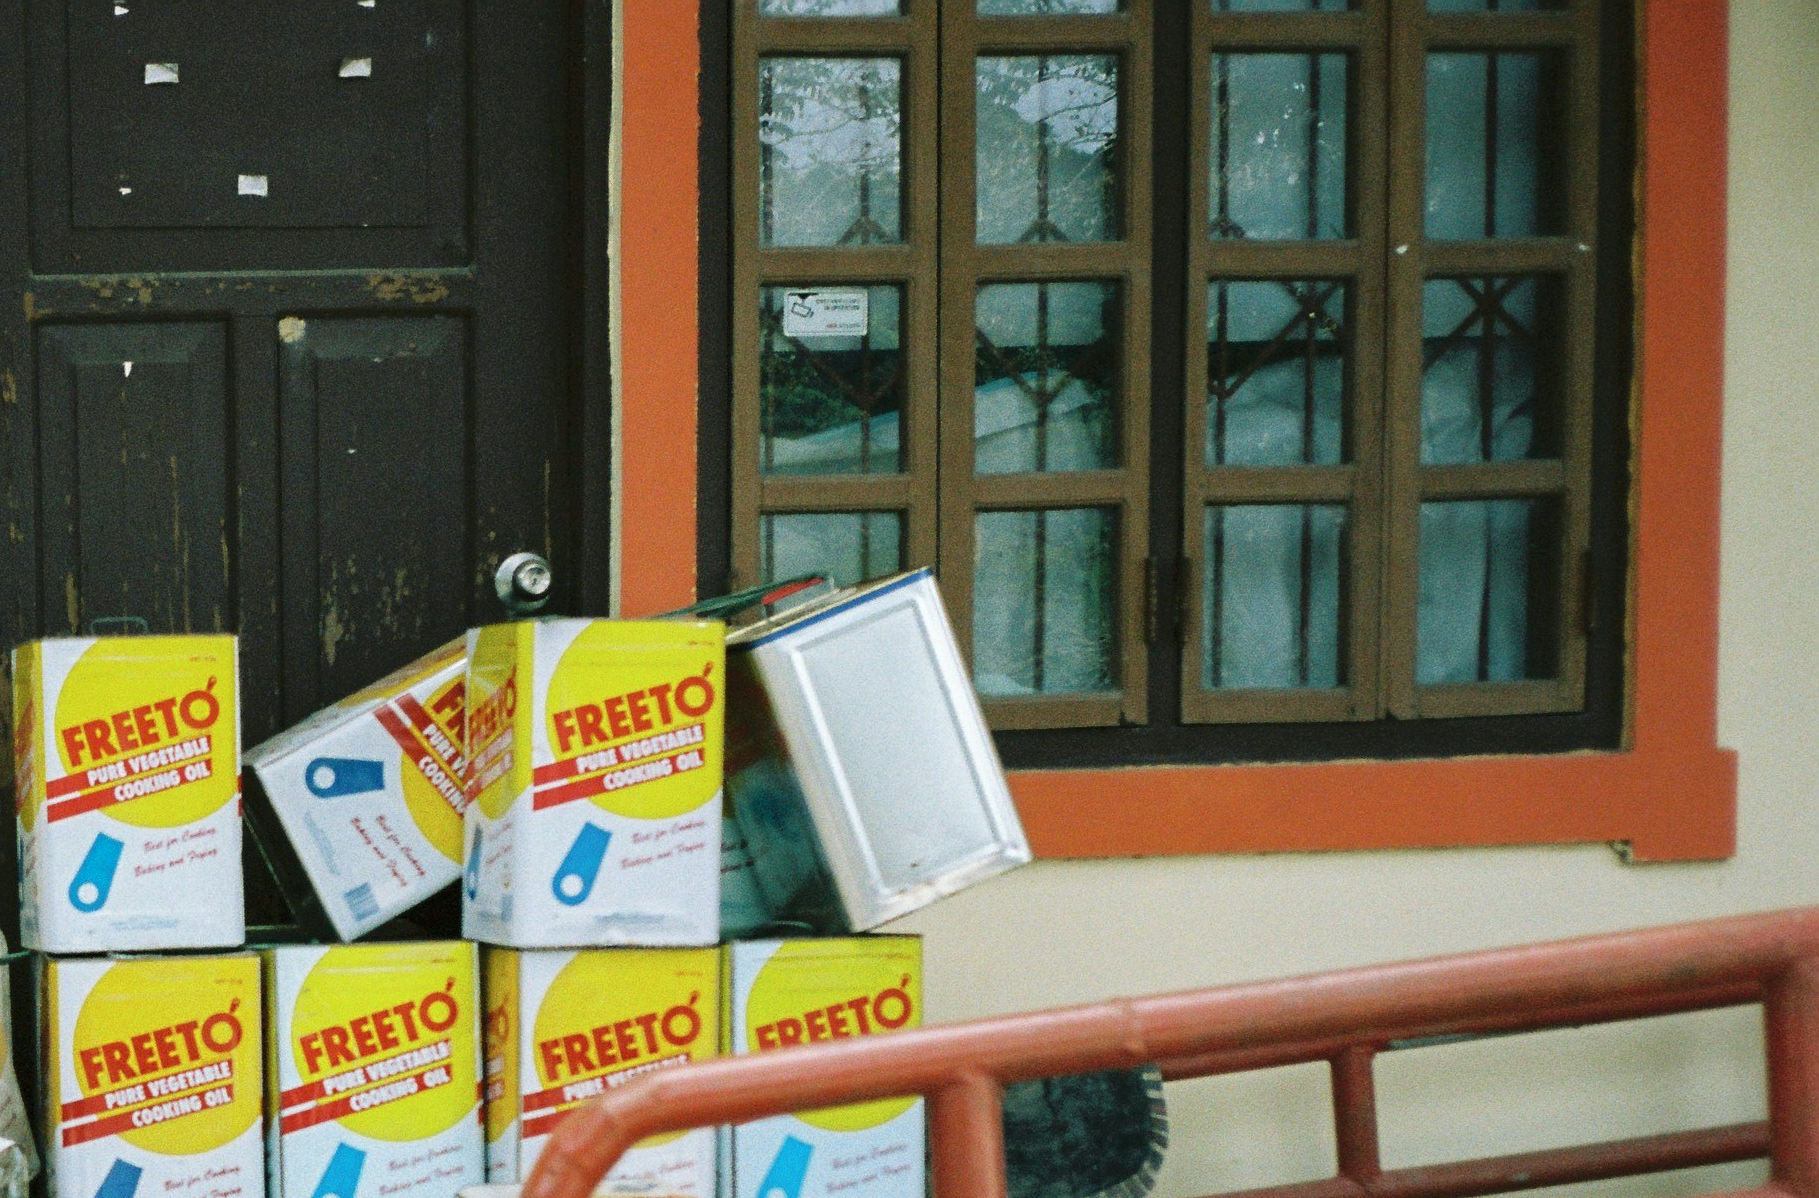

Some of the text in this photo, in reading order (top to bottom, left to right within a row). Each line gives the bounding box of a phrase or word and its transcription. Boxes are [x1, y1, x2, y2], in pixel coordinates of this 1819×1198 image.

[61, 675, 220, 767] FREETO
[553, 661, 715, 753] FREETO
[88, 737, 210, 786] PURE VEGETABLE
[576, 724, 704, 774] PURE VEGETABLE
[603, 751, 702, 790] COOKING OIL
[114, 761, 210, 802] COOKING OIL
[299, 977, 458, 1075] FREETO
[540, 990, 701, 1082] FREETO
[756, 973, 911, 1052] FREETO
[80, 997, 242, 1090] FREETO
[323, 1040, 451, 1095] PURE VEGETABLE
[106, 1061, 231, 1109] PURE VEGETABLE
[131, 1088, 231, 1127] COOKING OIL
[349, 1066, 450, 1112] COOKING OIL
